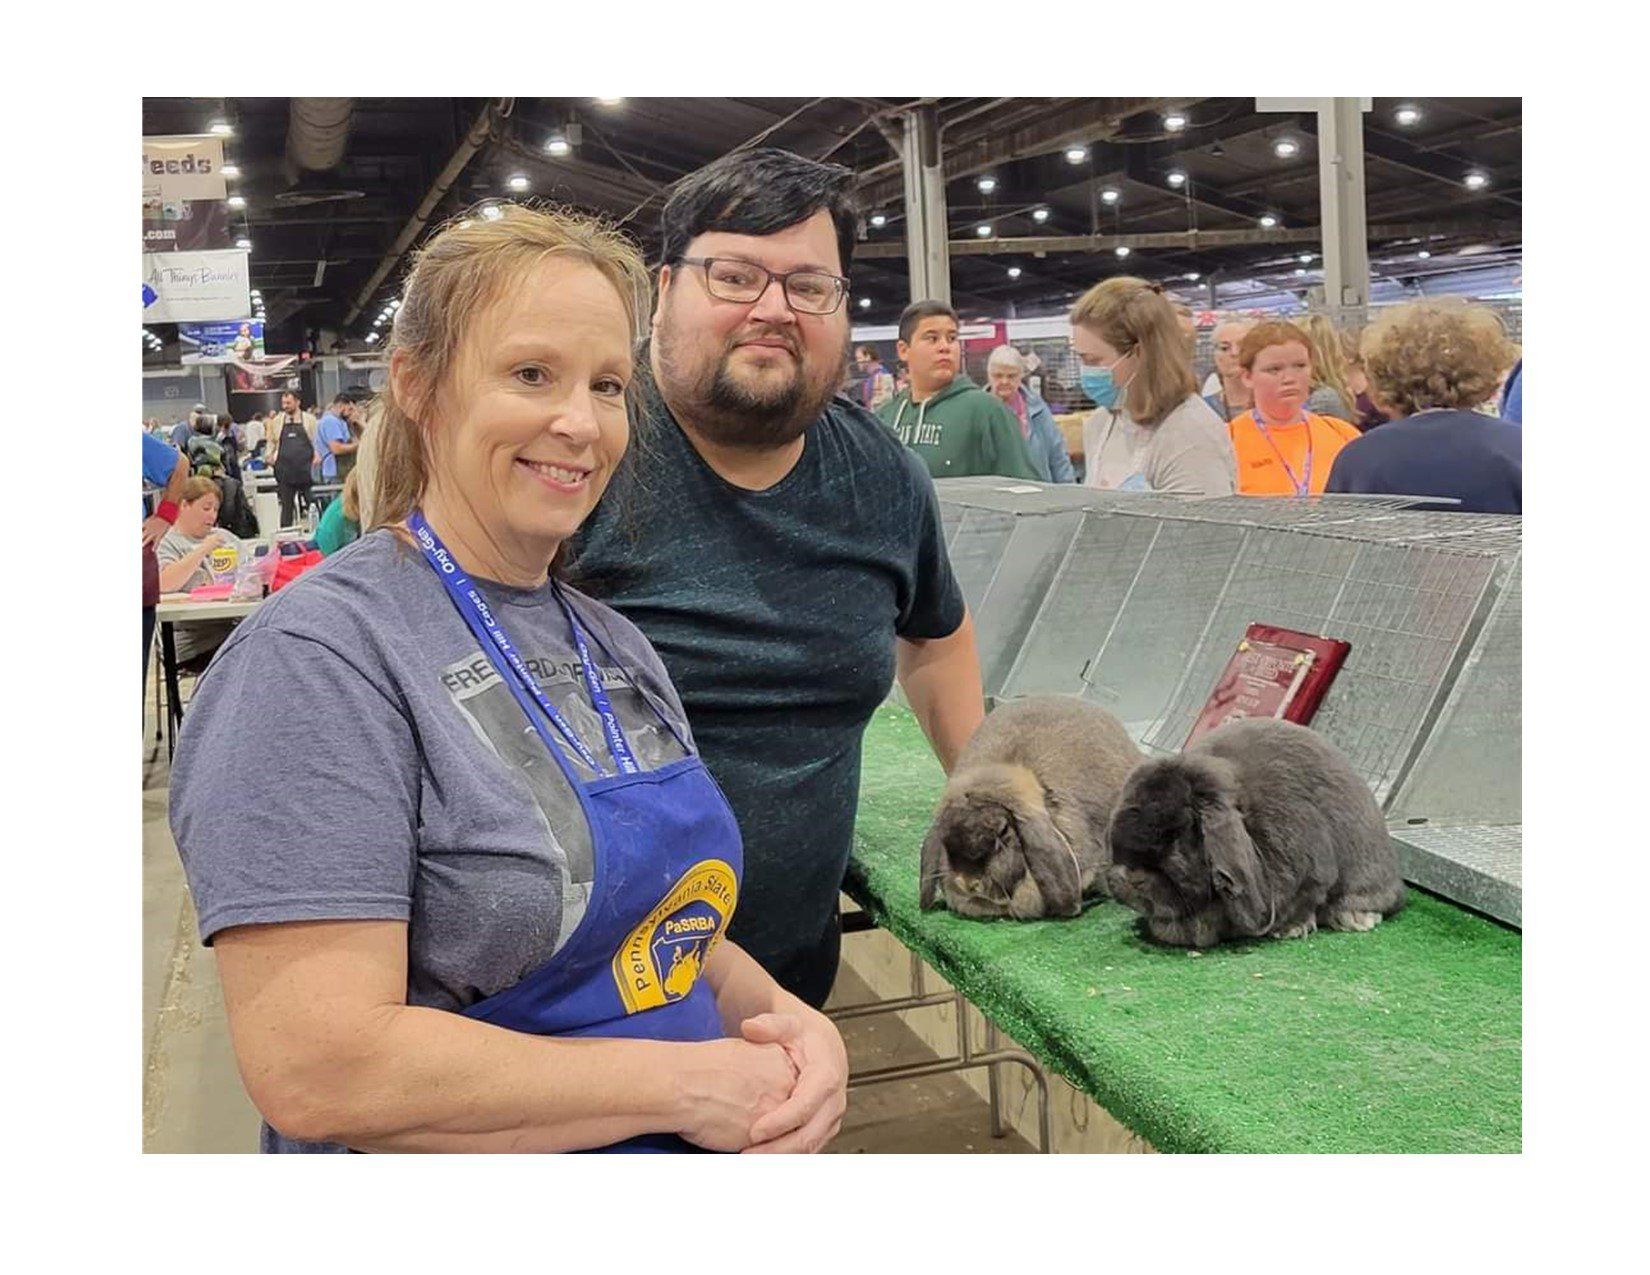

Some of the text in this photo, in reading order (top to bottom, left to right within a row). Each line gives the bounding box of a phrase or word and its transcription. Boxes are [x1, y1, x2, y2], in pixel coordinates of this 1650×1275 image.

[417, 526, 456, 574] Oxy-Gen
[467, 589, 496, 627] Cages
[704, 874, 732, 906] State
[664, 915, 717, 936] PaSRBA
